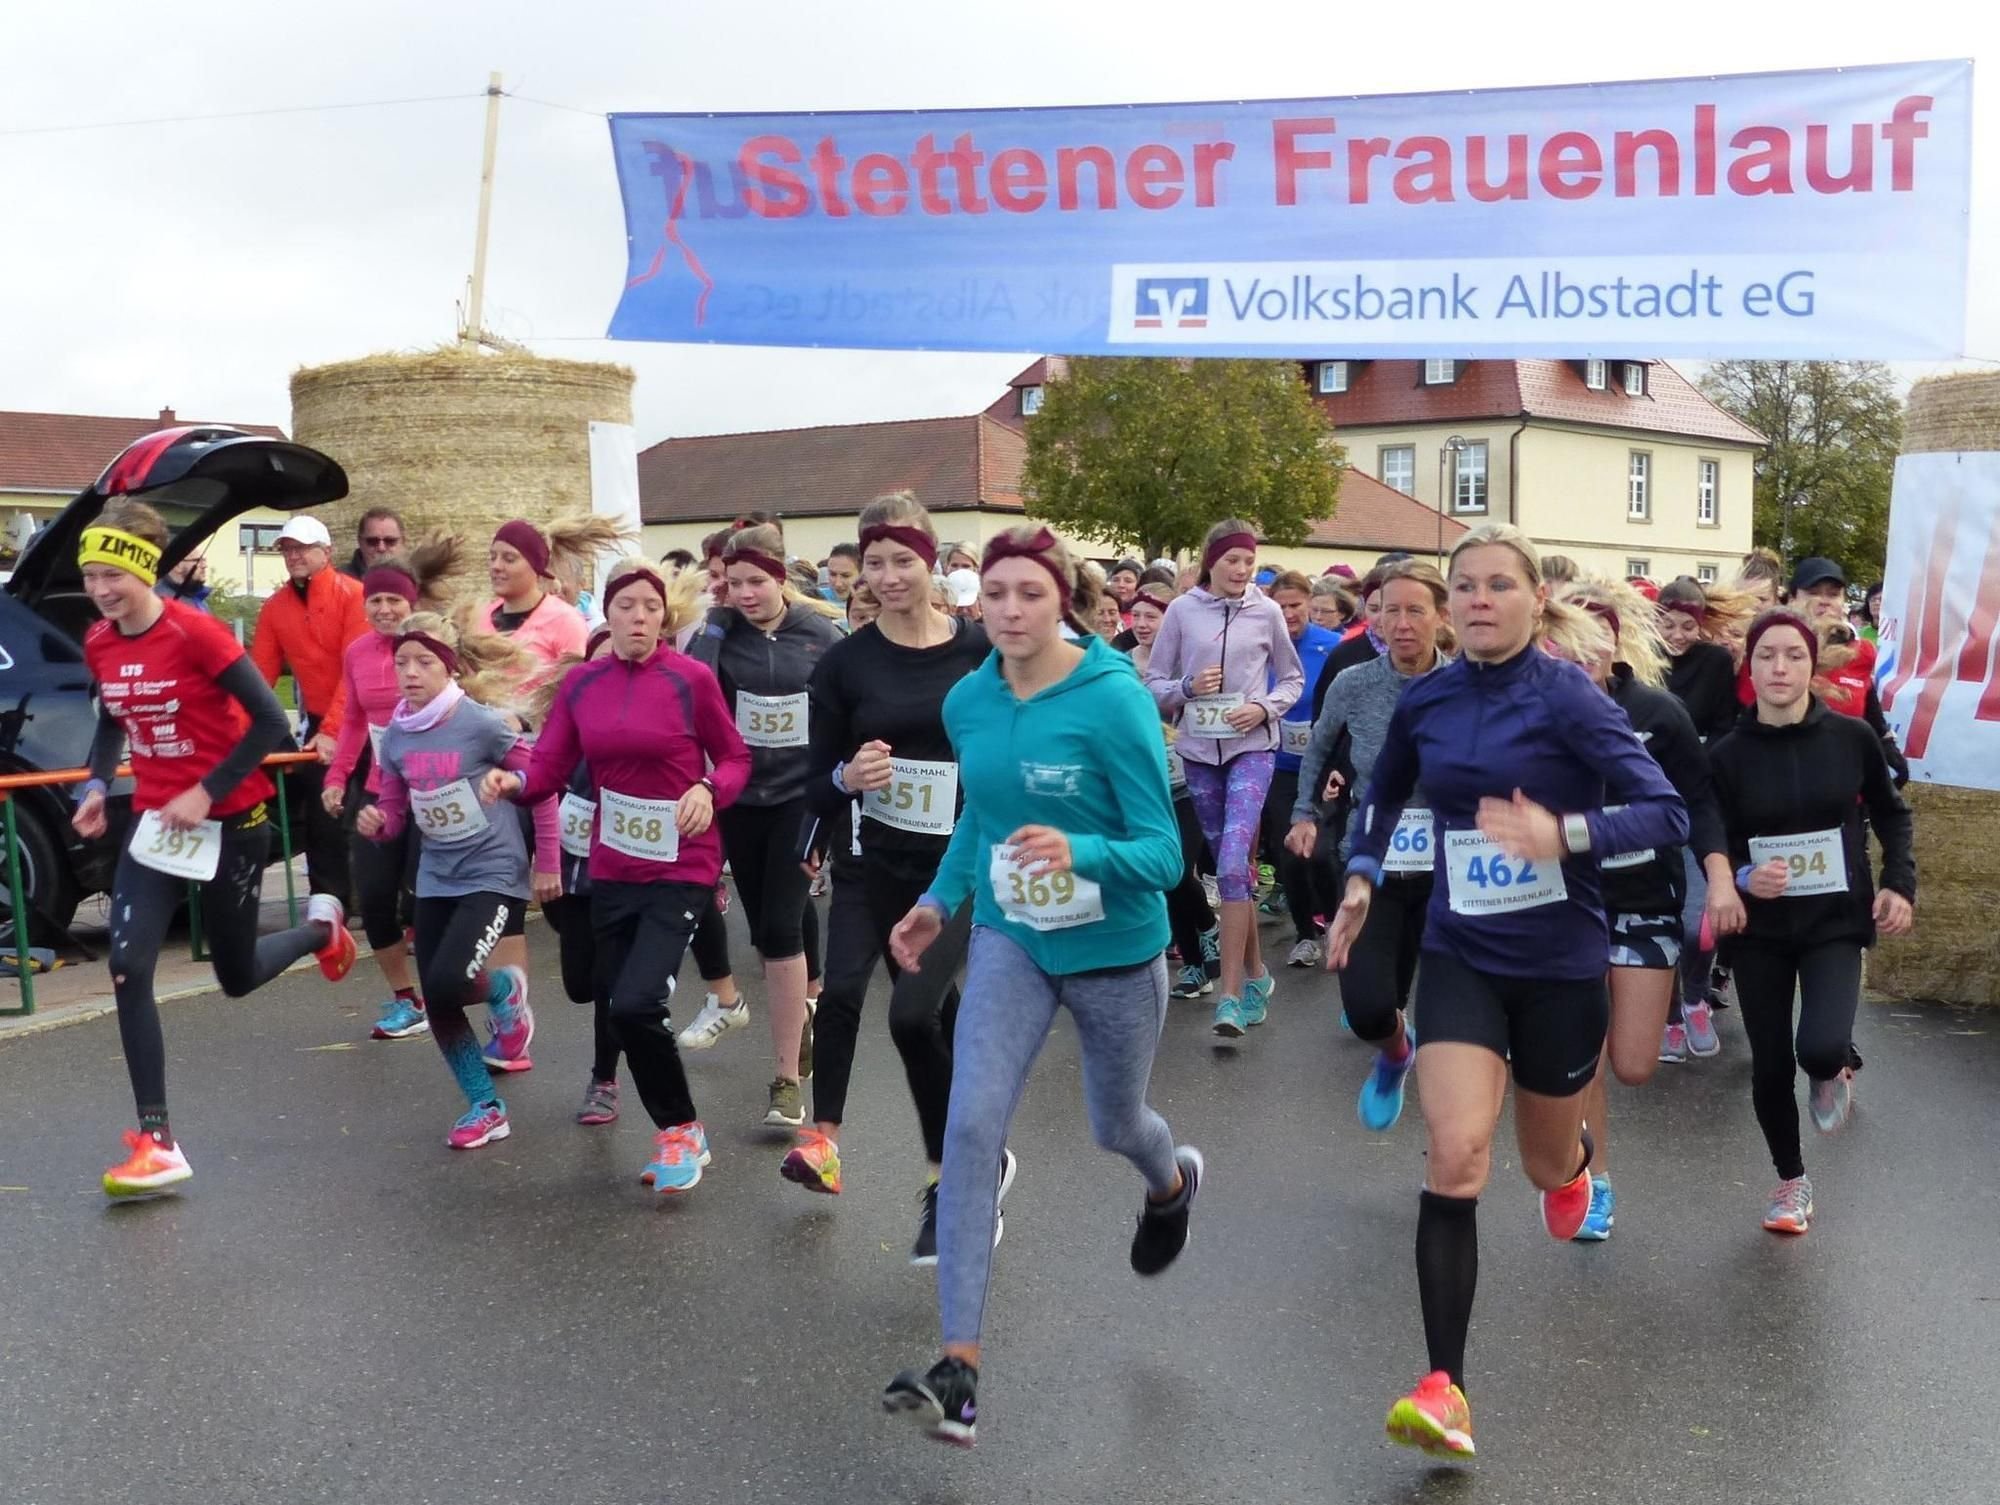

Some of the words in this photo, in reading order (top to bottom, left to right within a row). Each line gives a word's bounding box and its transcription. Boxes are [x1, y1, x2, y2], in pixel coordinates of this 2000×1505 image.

[736, 132, 1235, 219] Stettener
[1271, 95, 1935, 206] Frauenlauf
[1223, 272, 1479, 321] Volksbank
[1495, 269, 1723, 318] Albstadt
[1742, 270, 1815, 317] eG
[120, 664, 144, 678] LTS
[749, 710, 794, 734] 352
[920, 768, 948, 777] MAHL
[648, 804, 672, 813] MAHL
[878, 781, 933, 813] 351
[420, 801, 466, 828] 393
[564, 813, 593, 839] 39
[613, 810, 663, 843] 368
[148, 831, 203, 859] 397
[1393, 827, 1428, 852] 66
[1758, 840, 1806, 849] BACKHAUS
[1807, 836, 1832, 845] MAHL
[1466, 852, 1538, 889] 462
[1007, 869, 1075, 907] 369
[466, 904, 509, 979] adidas
